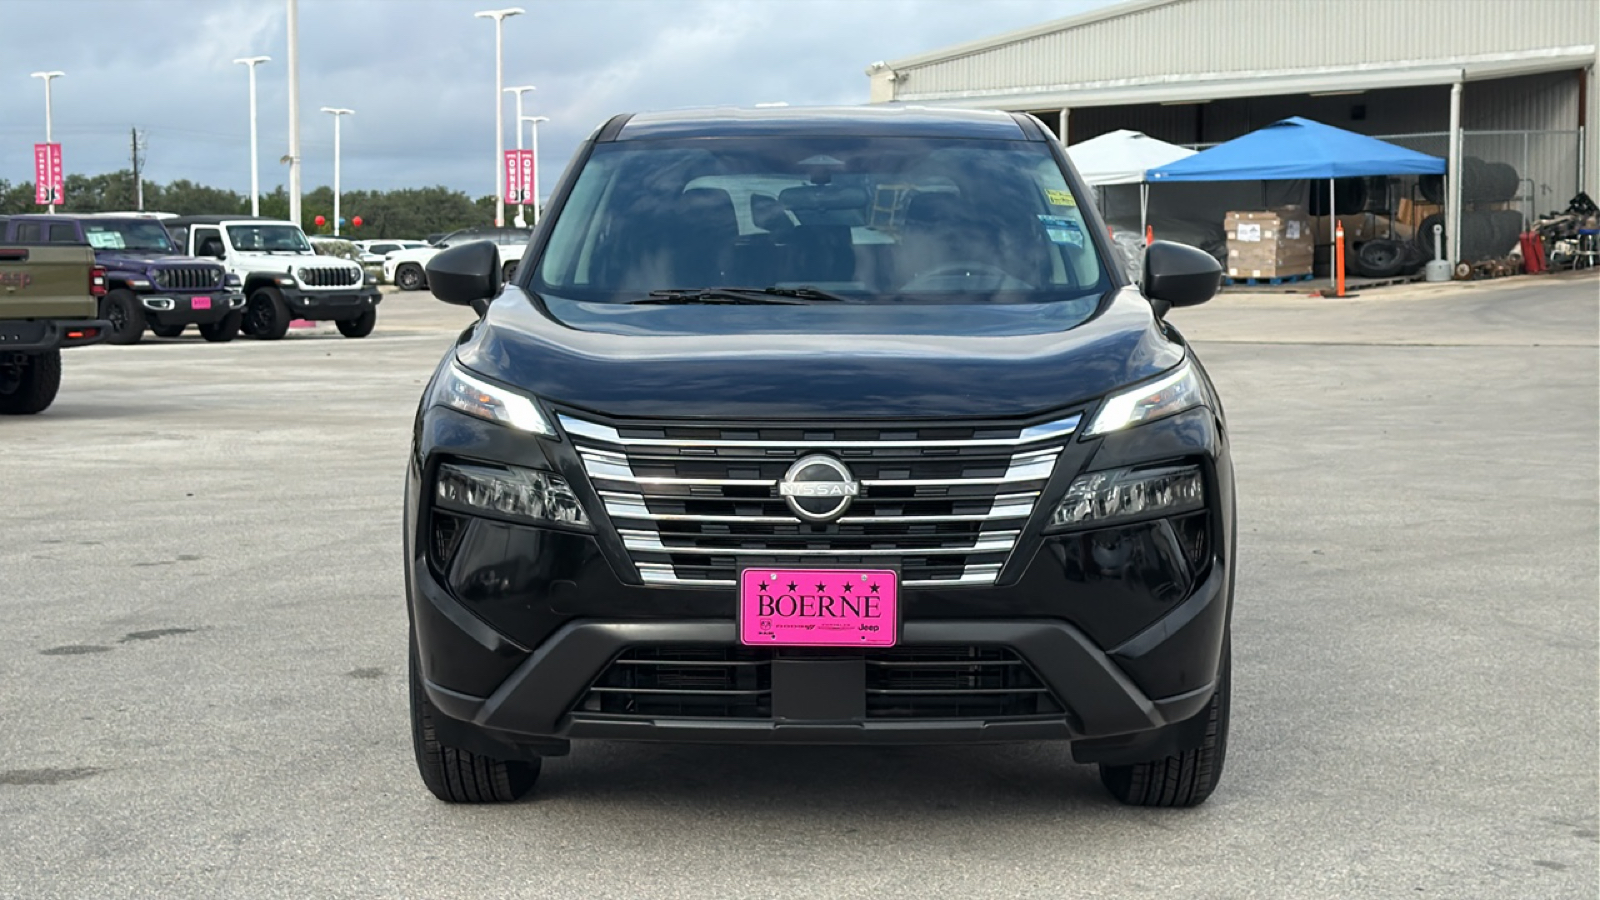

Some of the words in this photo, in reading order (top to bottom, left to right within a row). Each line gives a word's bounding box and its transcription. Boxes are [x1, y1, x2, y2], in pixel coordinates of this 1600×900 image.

[782, 484, 856, 495] NISSAN
[756, 594, 882, 618] BOERNE
[858, 623, 880, 633] Jeep
